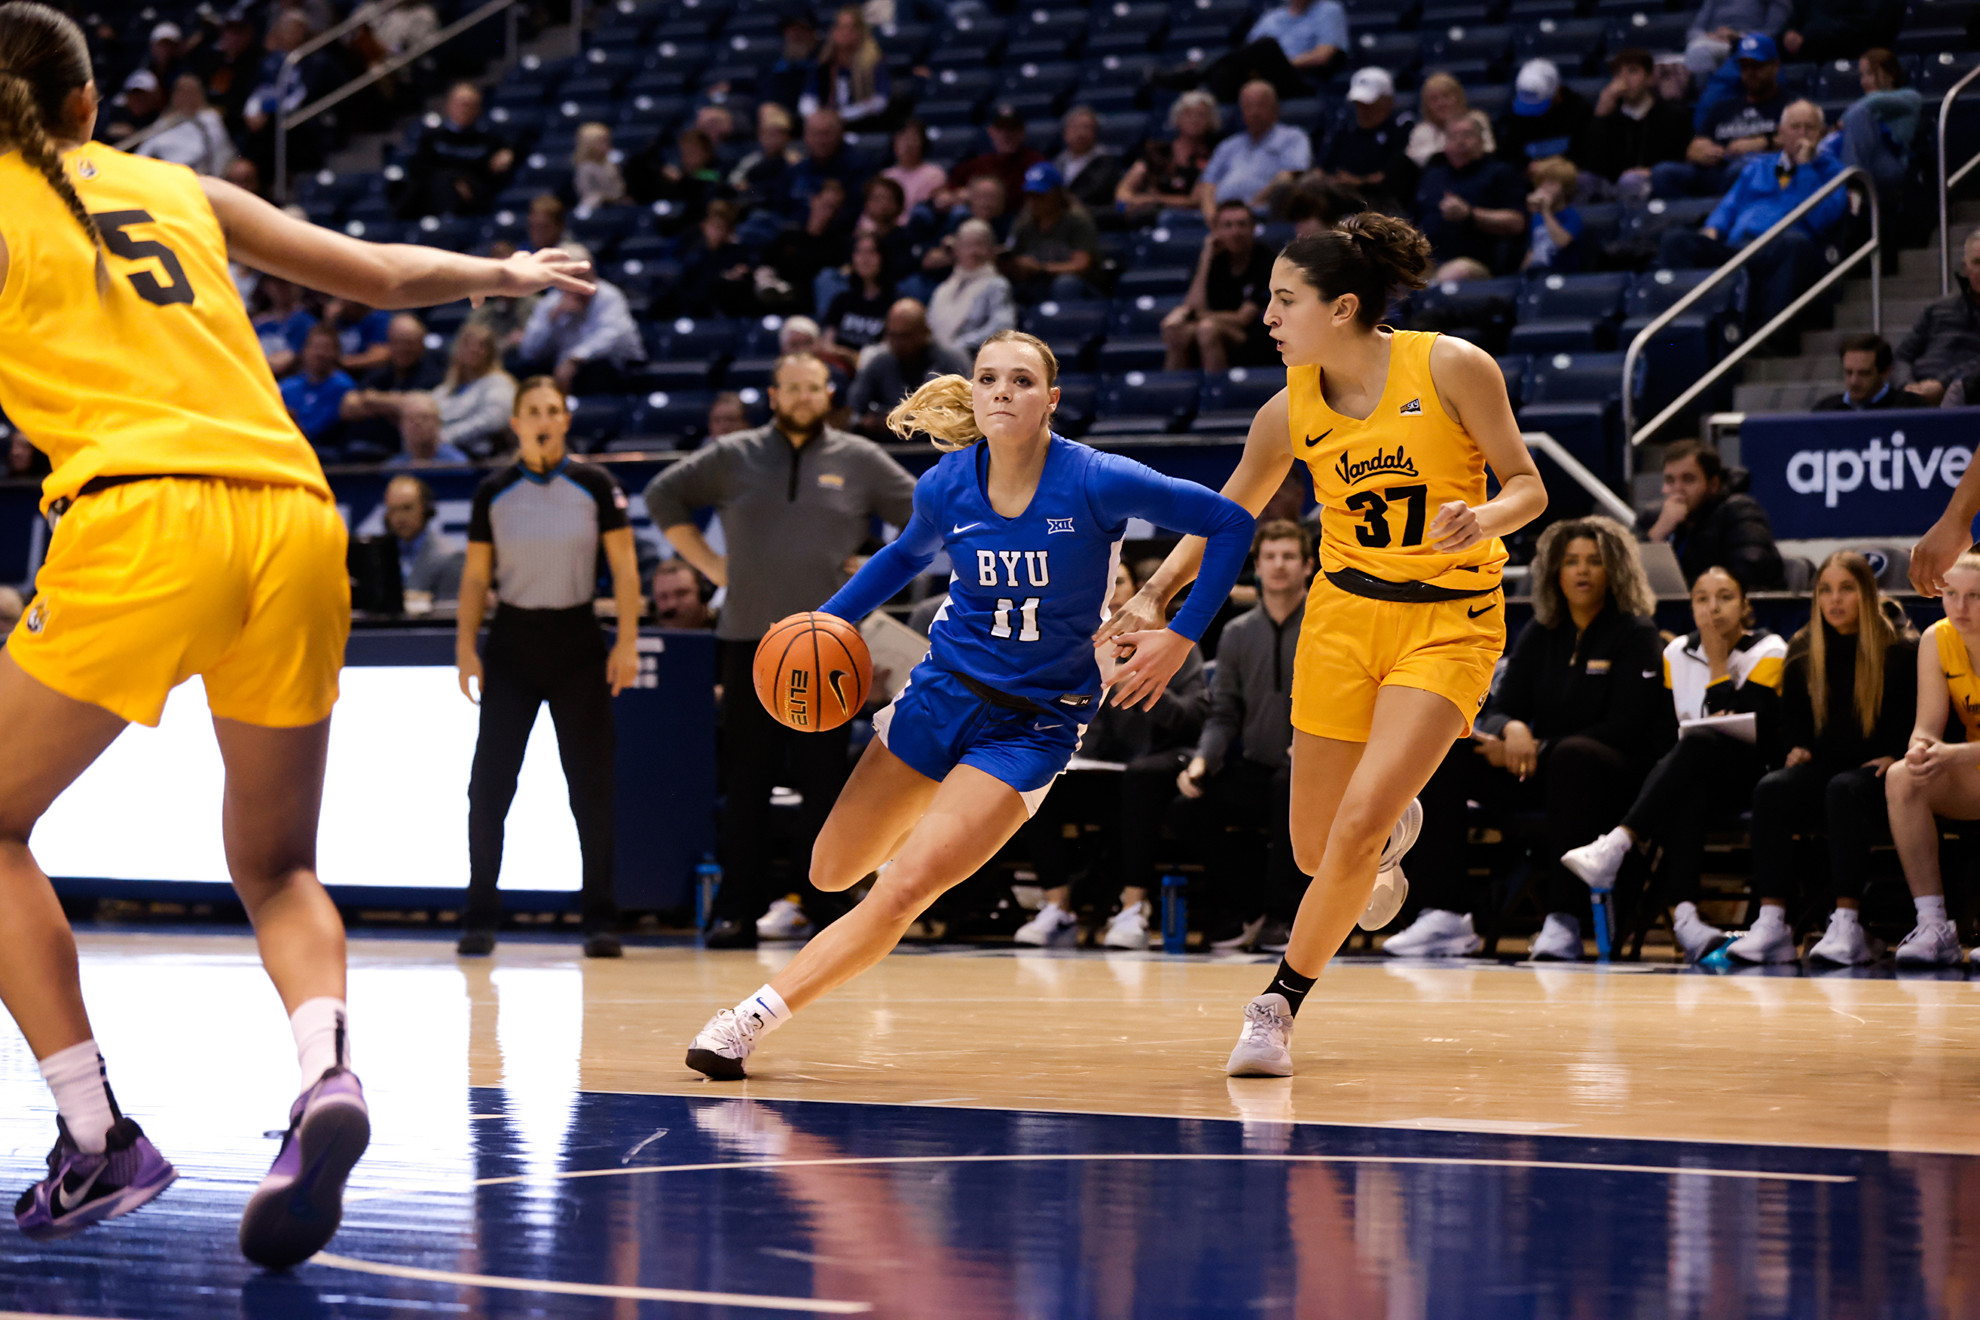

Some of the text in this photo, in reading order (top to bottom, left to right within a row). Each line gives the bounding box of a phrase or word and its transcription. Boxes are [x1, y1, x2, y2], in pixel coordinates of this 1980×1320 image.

[91, 210, 196, 307] 5
[1335, 445, 1418, 485] Vandals
[1786, 430, 1973, 508] aptive
[1345, 484, 1427, 548] 37
[976, 550, 1050, 587] BYU
[990, 597, 1040, 642] 11
[790, 669, 809, 726] ELITE
